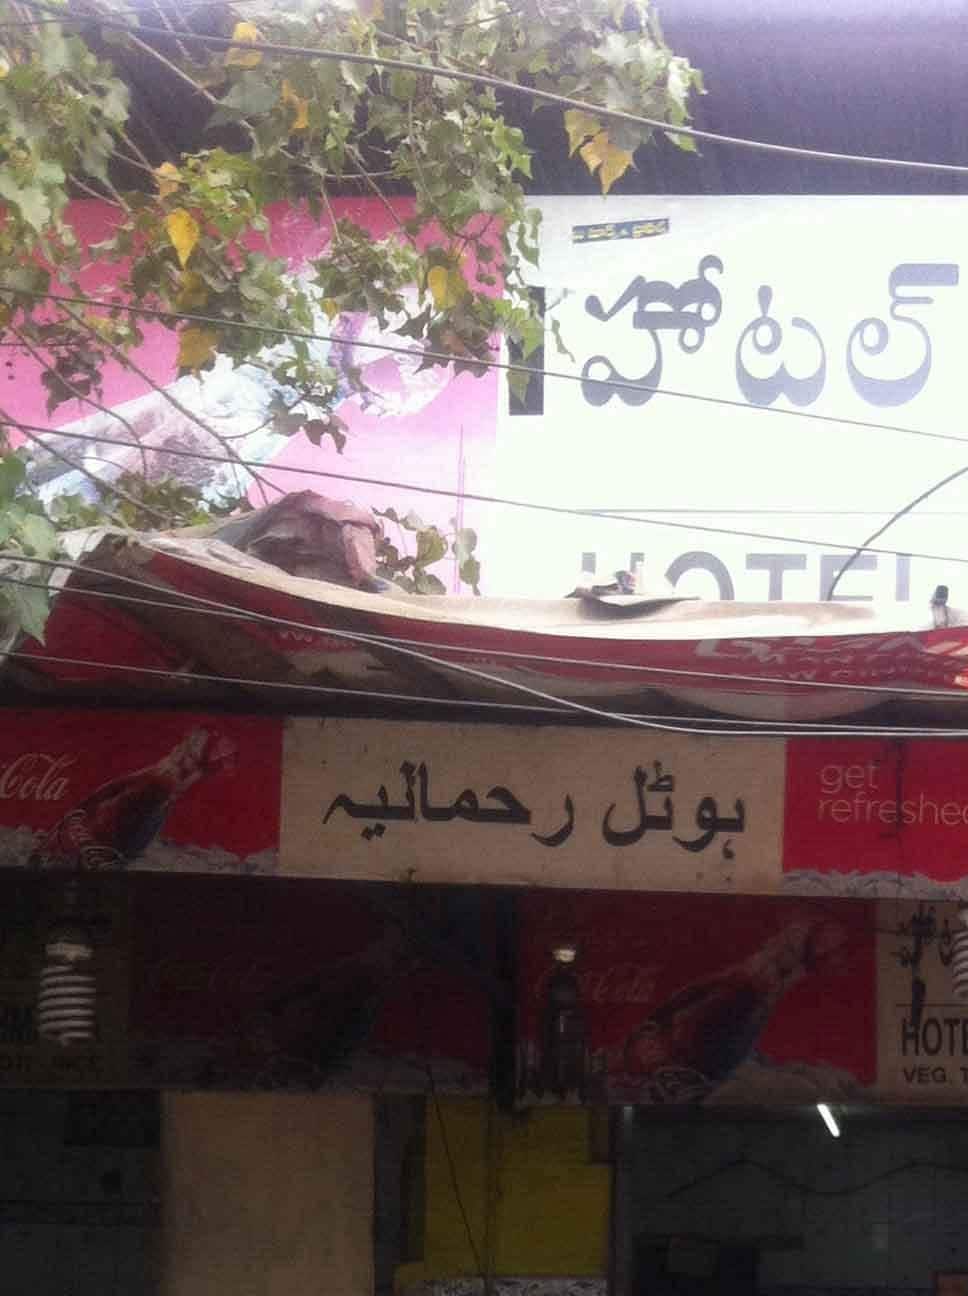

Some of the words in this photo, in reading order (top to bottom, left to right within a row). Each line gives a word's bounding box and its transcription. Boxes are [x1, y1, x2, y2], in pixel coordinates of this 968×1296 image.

[580, 550, 912, 602] OTE
[820, 760, 879, 794] get
[603, 760, 745, 860] ہوٹل
